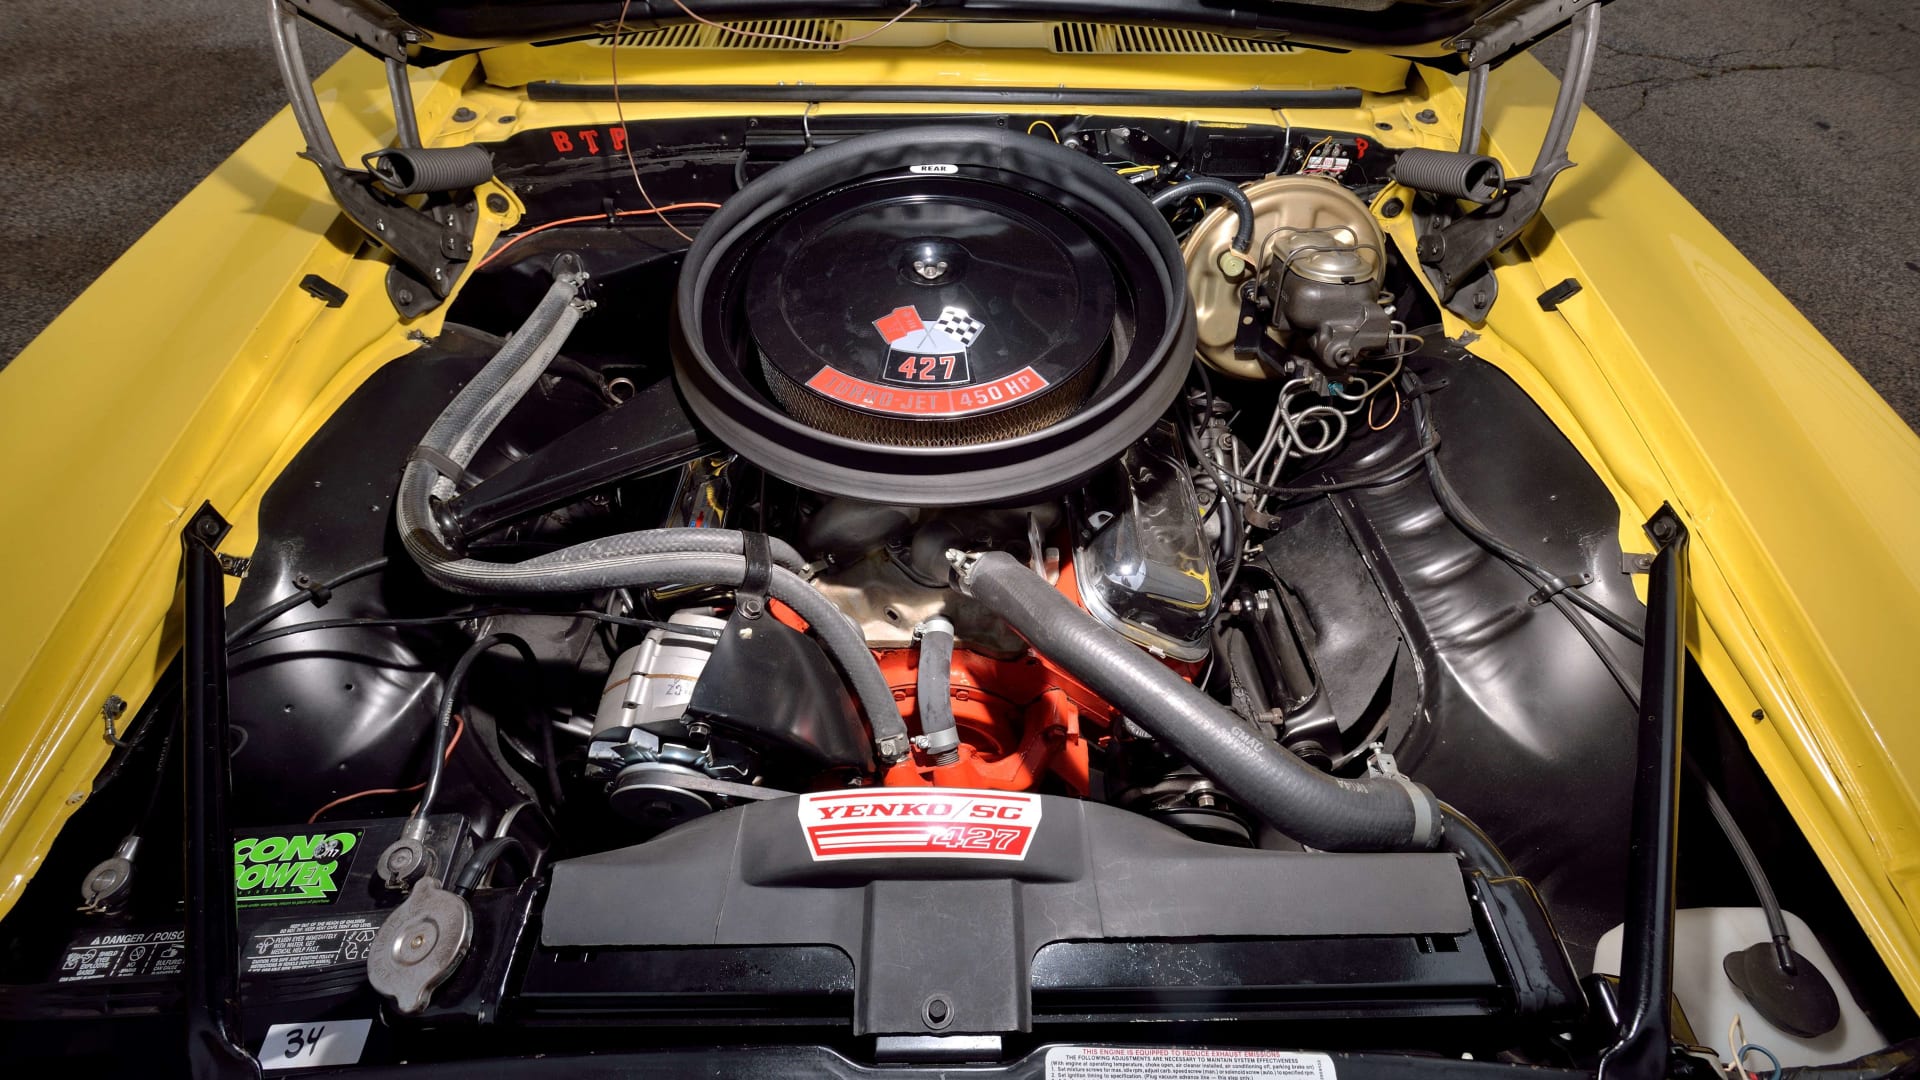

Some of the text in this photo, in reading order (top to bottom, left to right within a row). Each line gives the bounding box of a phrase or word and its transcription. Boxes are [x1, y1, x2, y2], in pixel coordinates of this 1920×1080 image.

[551, 131, 573, 152] B
[578, 130, 599, 155] T
[898, 355, 956, 380] 427
[824, 374, 1032, 411] TURBO-JET 450 HP
[930, 827, 1021, 850] 427
[102, 934, 144, 944] DANGER
[285, 1026, 326, 1058] 34
